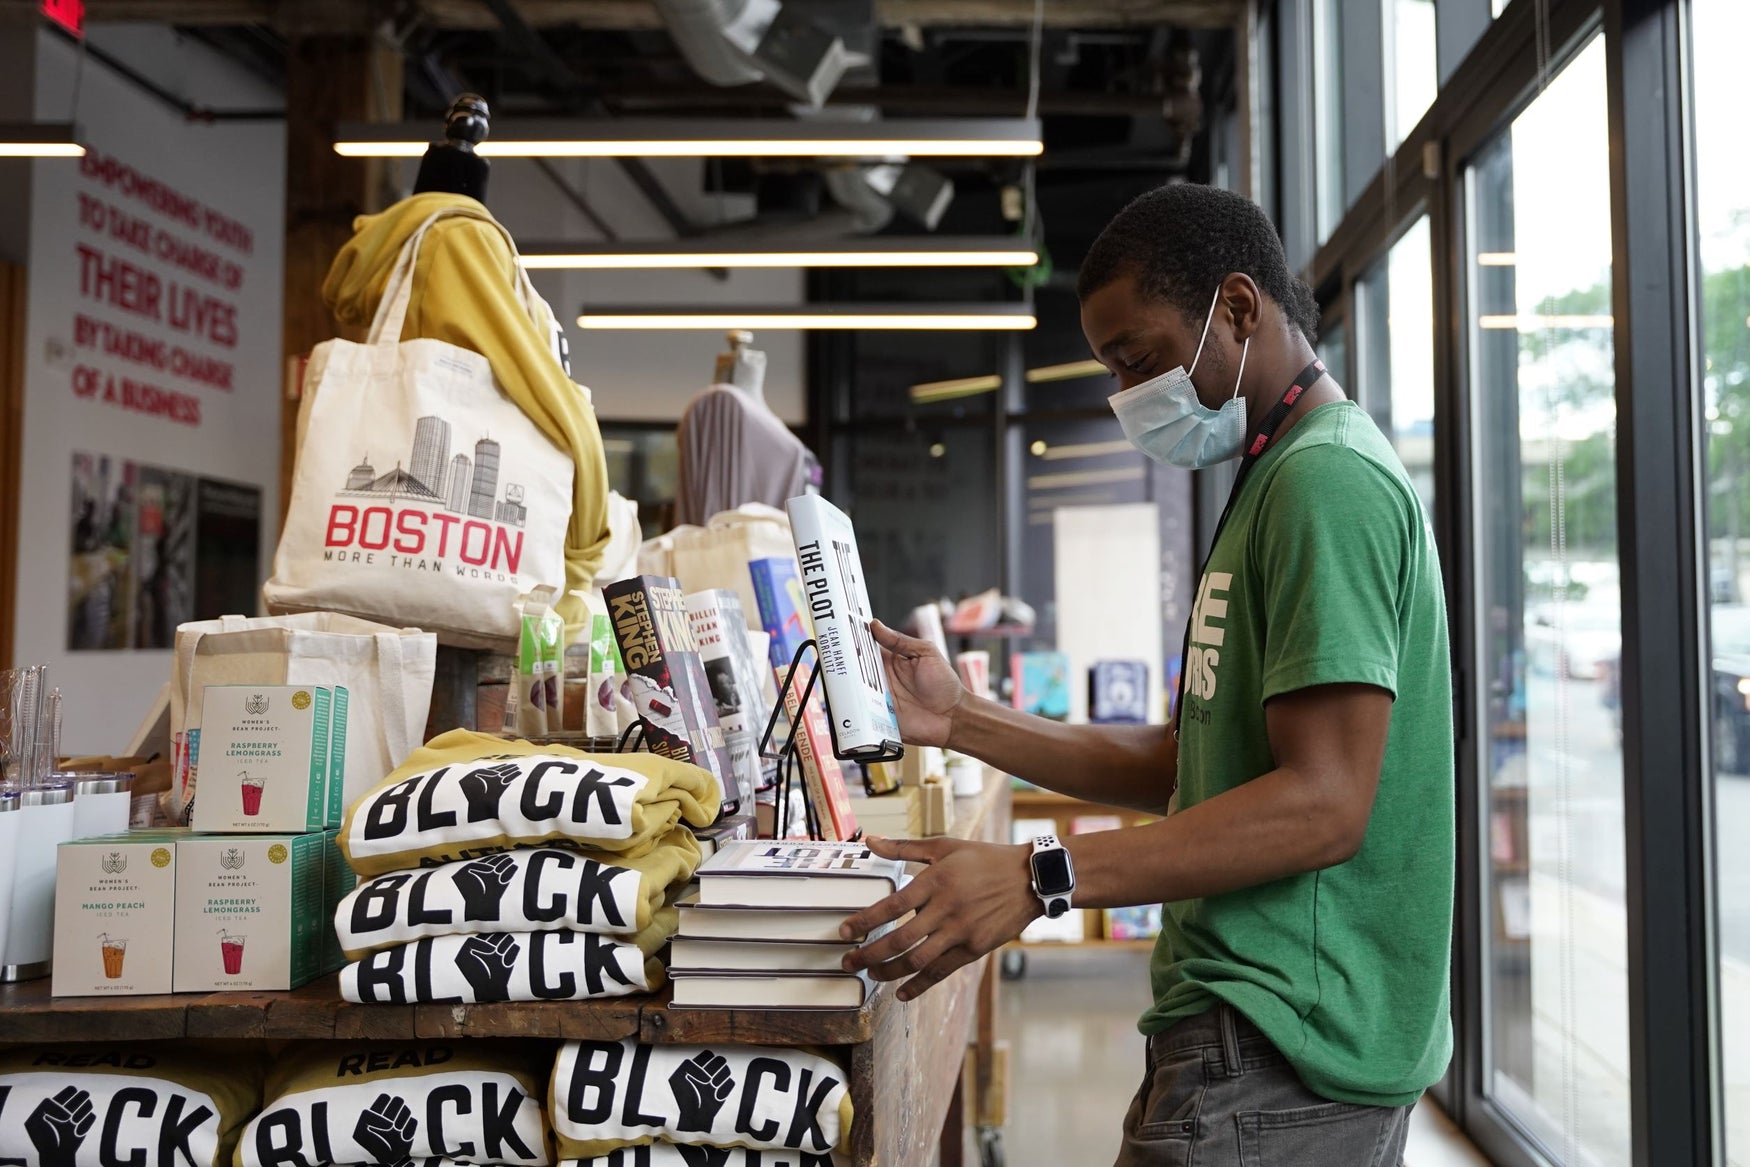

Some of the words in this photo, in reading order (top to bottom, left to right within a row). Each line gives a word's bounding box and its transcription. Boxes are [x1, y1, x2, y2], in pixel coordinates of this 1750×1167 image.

[79, 192, 107, 233] TO
[76, 242, 161, 322] THEIR
[169, 281, 237, 348] LIVES
[72, 365, 100, 397] OF
[325, 504, 525, 575] BOSTON
[324, 550, 376, 565] MORE
[391, 555, 442, 573] THAN
[456, 565, 519, 585] WORDS
[799, 540, 825, 576] THE
[649, 586, 686, 611] STEPHE
[807, 578, 835, 621] PLOT
[610, 593, 649, 670] KING
[632, 591, 662, 664] STEPHEN
[696, 622, 718, 634] JEAN
[827, 626, 840, 647] JEAN
[818, 633, 836, 674] KORELITZ
[833, 650, 848, 676] HANFF
[32, 1052, 157, 1069] READ
[337, 1048, 454, 1077] READ
